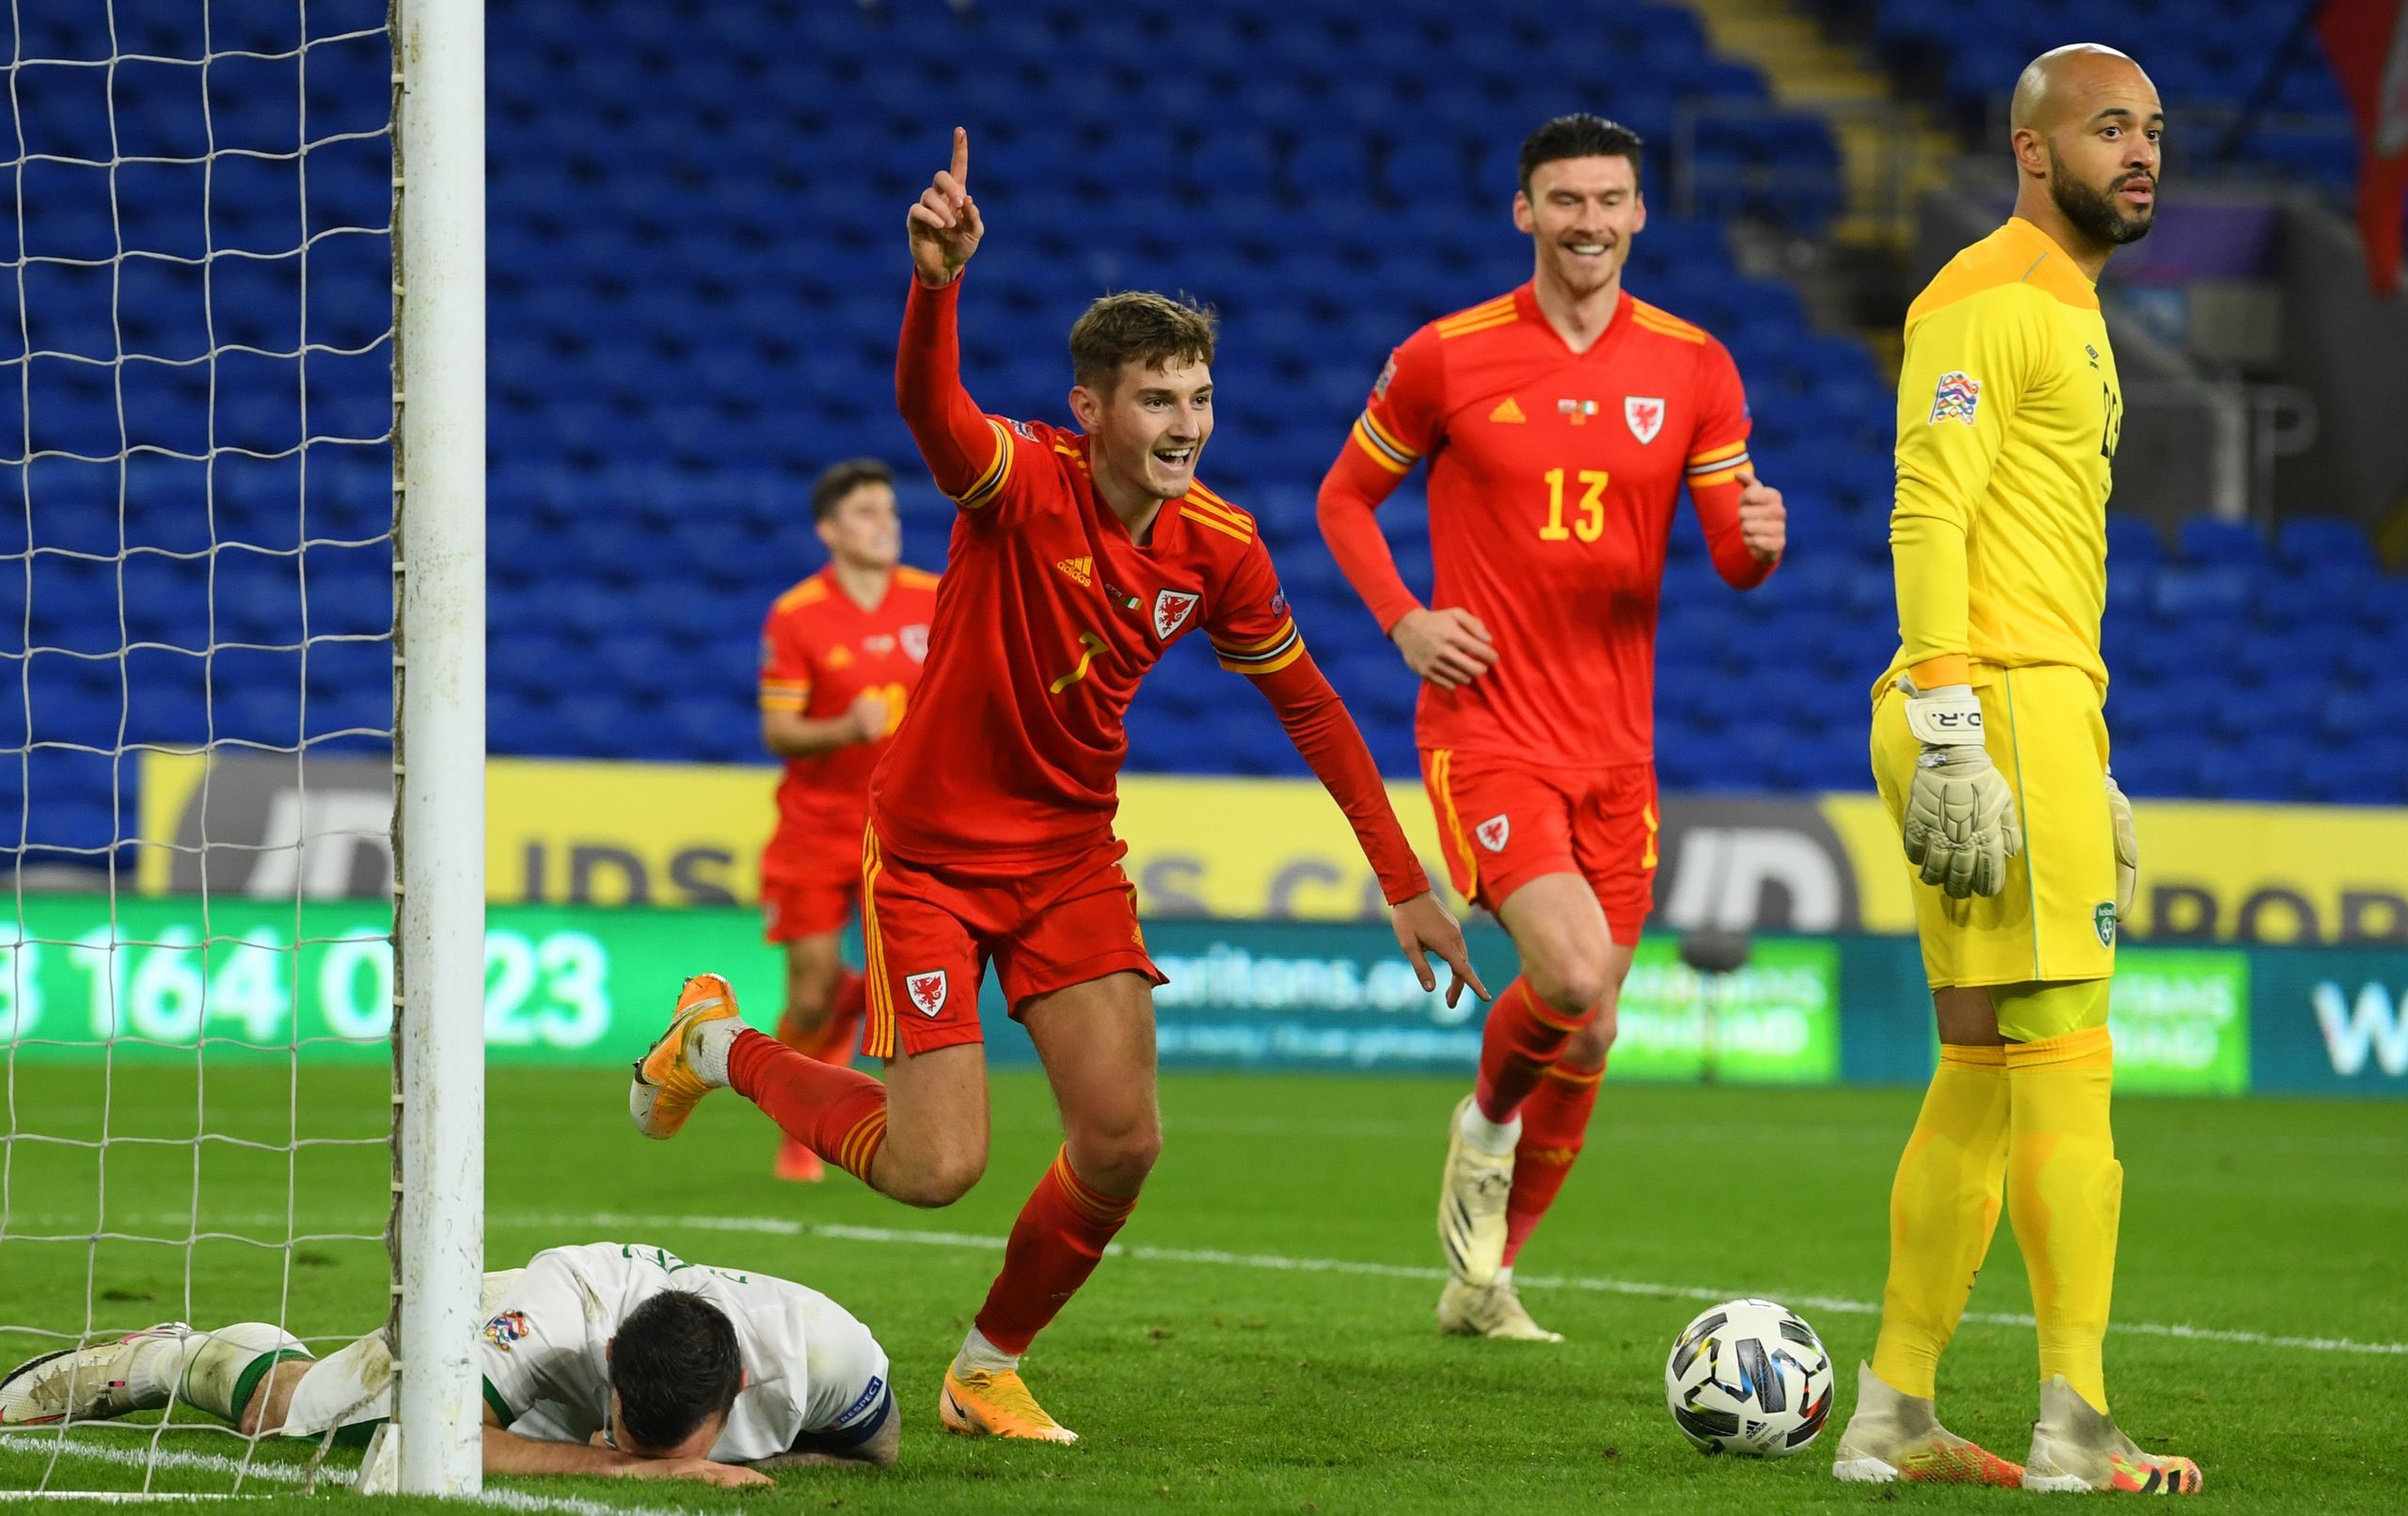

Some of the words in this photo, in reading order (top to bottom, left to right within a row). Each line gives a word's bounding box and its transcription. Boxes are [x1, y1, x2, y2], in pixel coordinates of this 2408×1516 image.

[1539, 468, 1609, 543] 13
[1056, 561, 1092, 588] adidas
[1050, 631, 1110, 694] 7
[1931, 712, 1981, 727] D.R.
[70, 924, 293, 1042] 164
[318, 927, 613, 1049] 023
[840, 1379, 880, 1422] RESPECT
[1746, 1421, 1767, 1440] adidas
